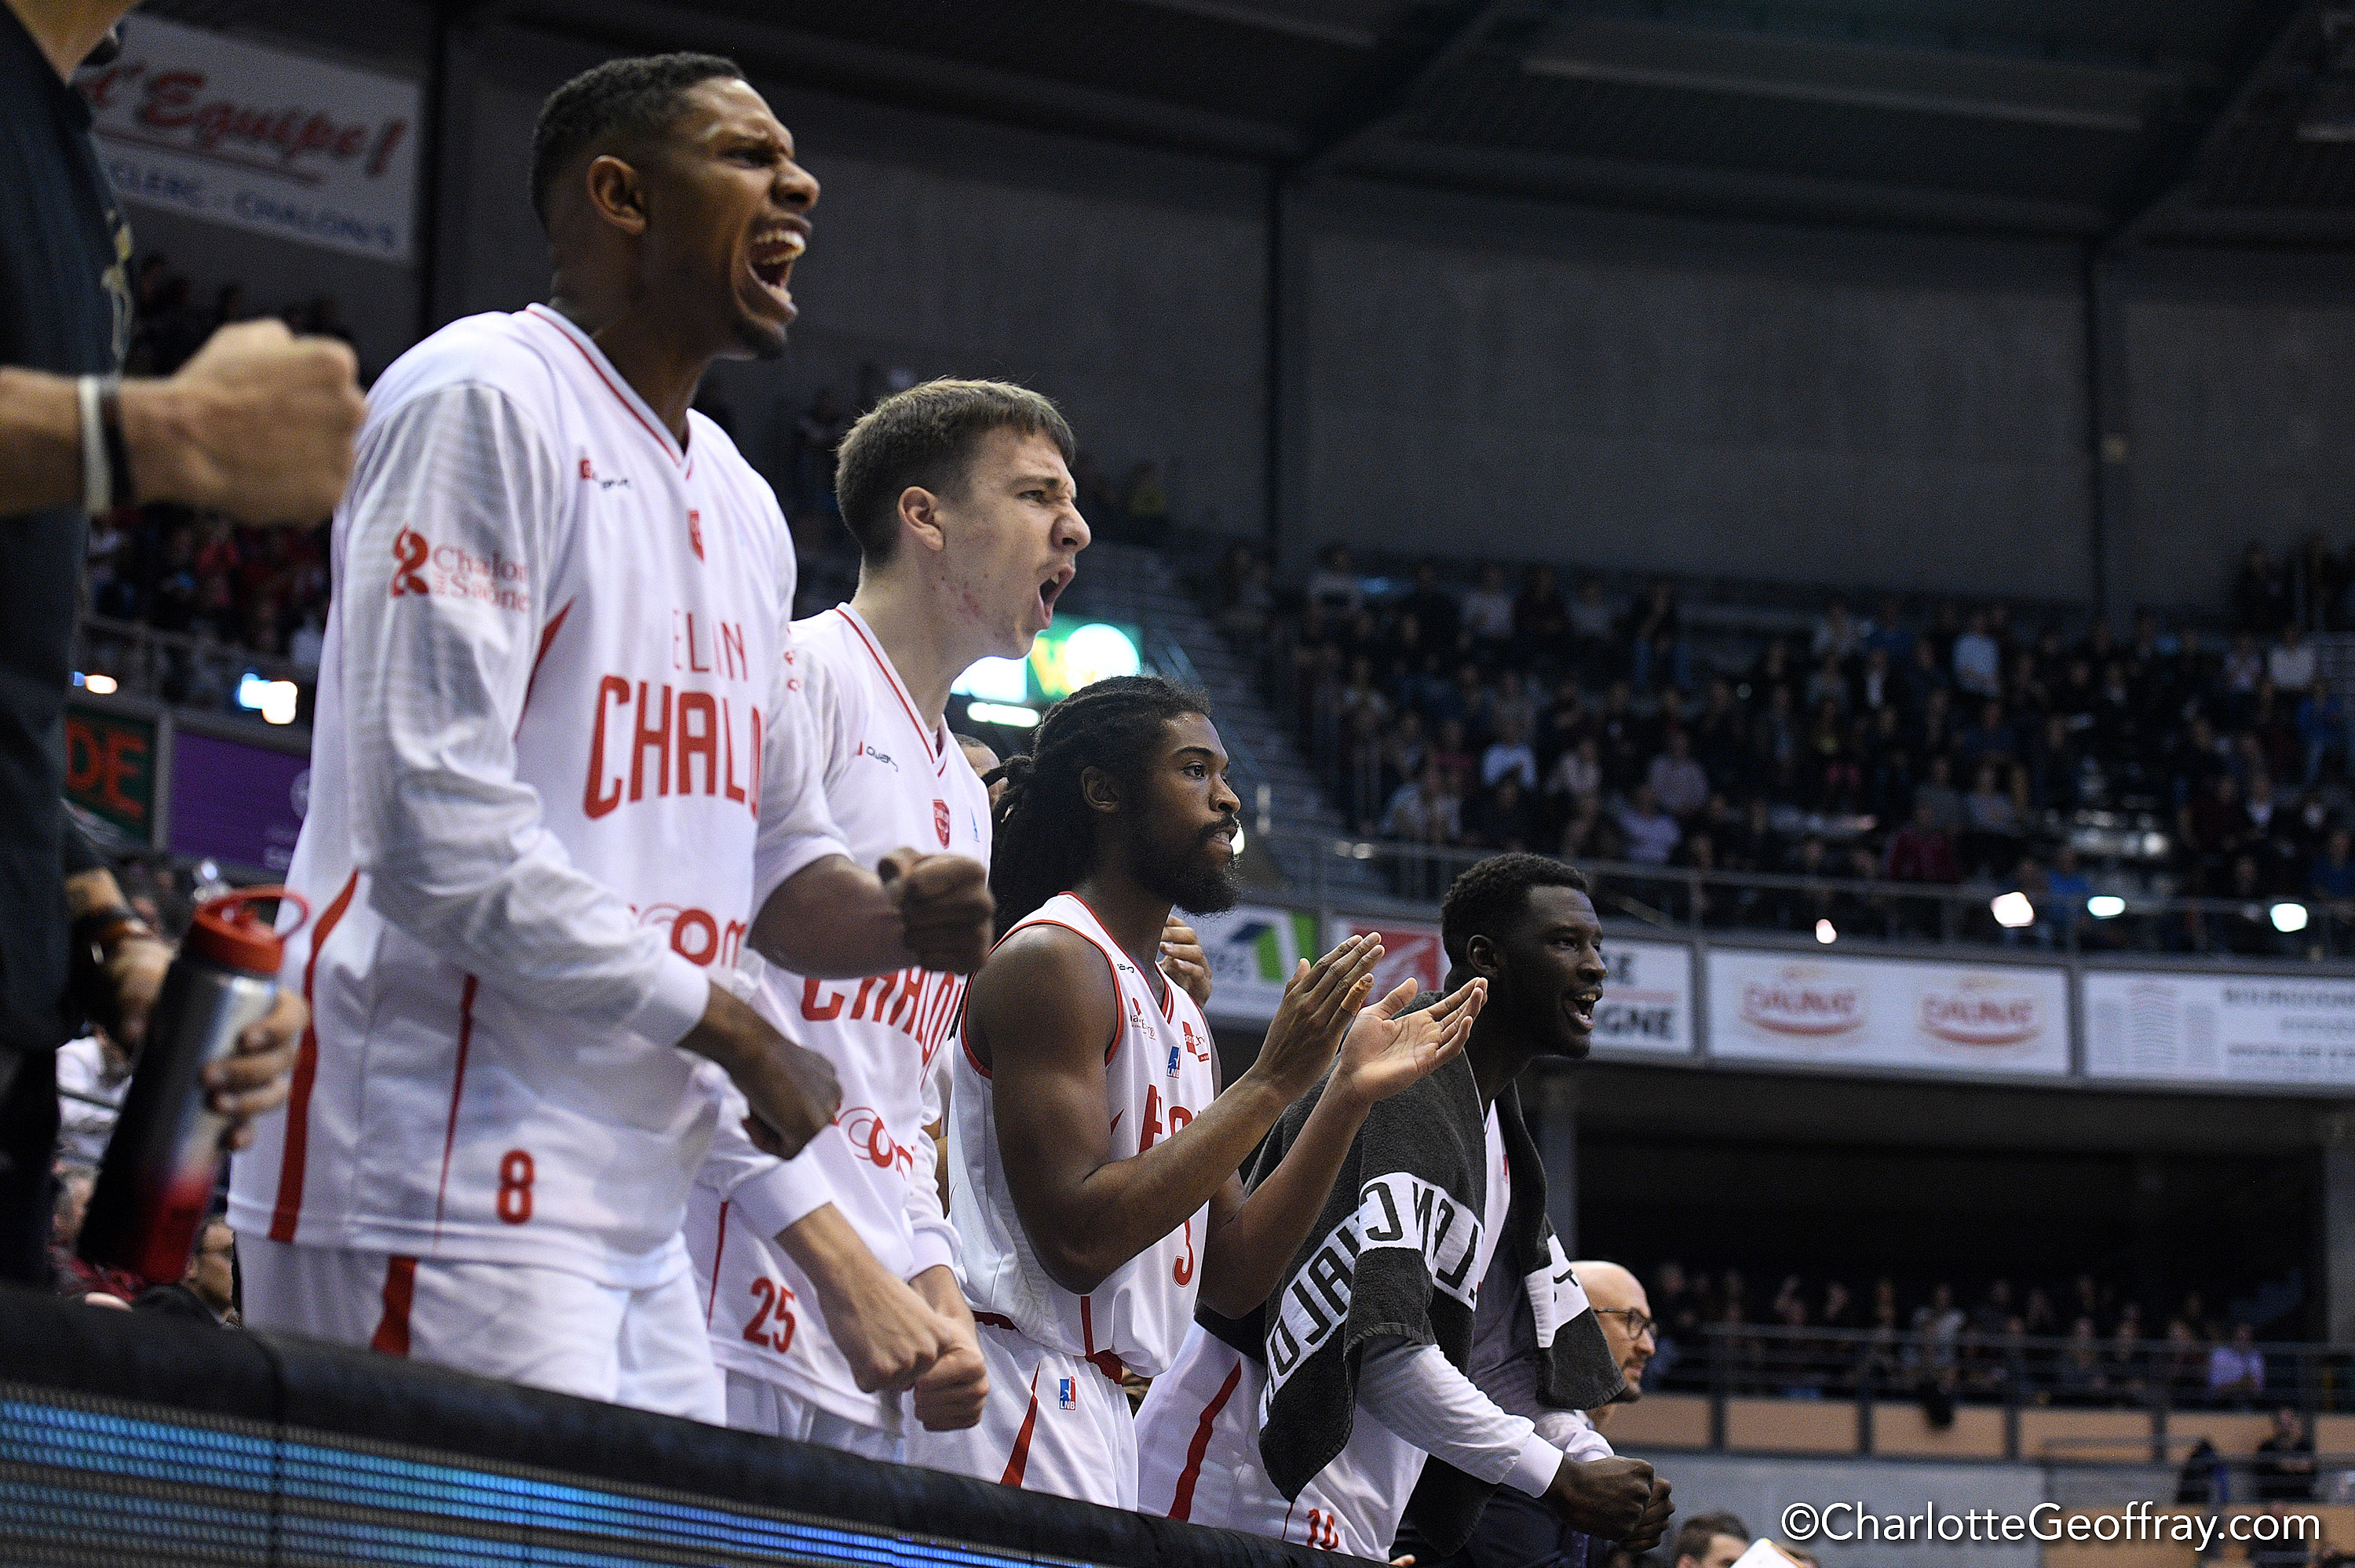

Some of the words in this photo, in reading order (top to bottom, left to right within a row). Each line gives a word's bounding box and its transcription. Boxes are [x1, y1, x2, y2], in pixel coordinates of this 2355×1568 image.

[497, 1149, 535, 1224] 8
[743, 1277, 796, 1354] 25
[1060, 1400, 1075, 1410] LNB
